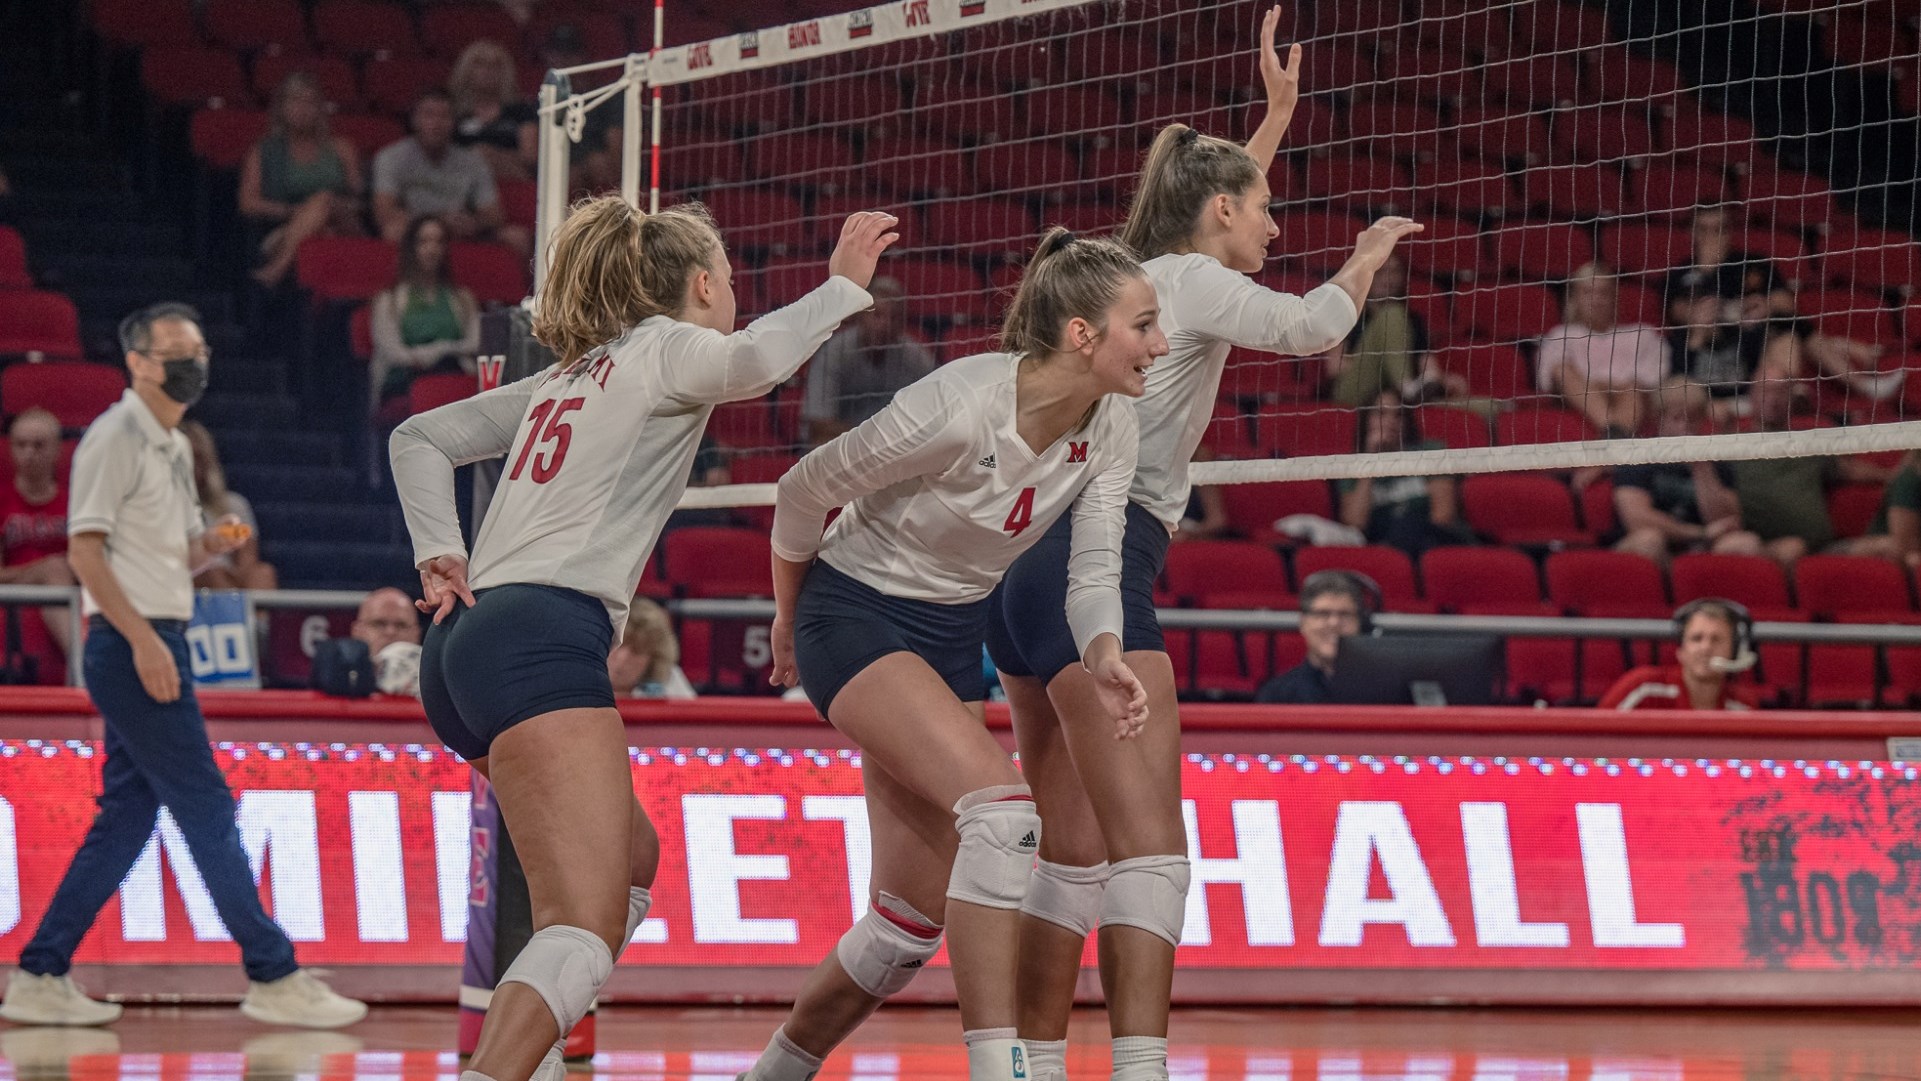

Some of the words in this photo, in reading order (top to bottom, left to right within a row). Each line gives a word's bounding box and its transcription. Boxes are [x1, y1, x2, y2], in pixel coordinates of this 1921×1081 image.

[508, 396, 587, 485] 15
[1065, 441, 1090, 463] M
[1003, 486, 1037, 539] 4
[743, 625, 771, 668] 5
[1181, 798, 1686, 948] HALL
